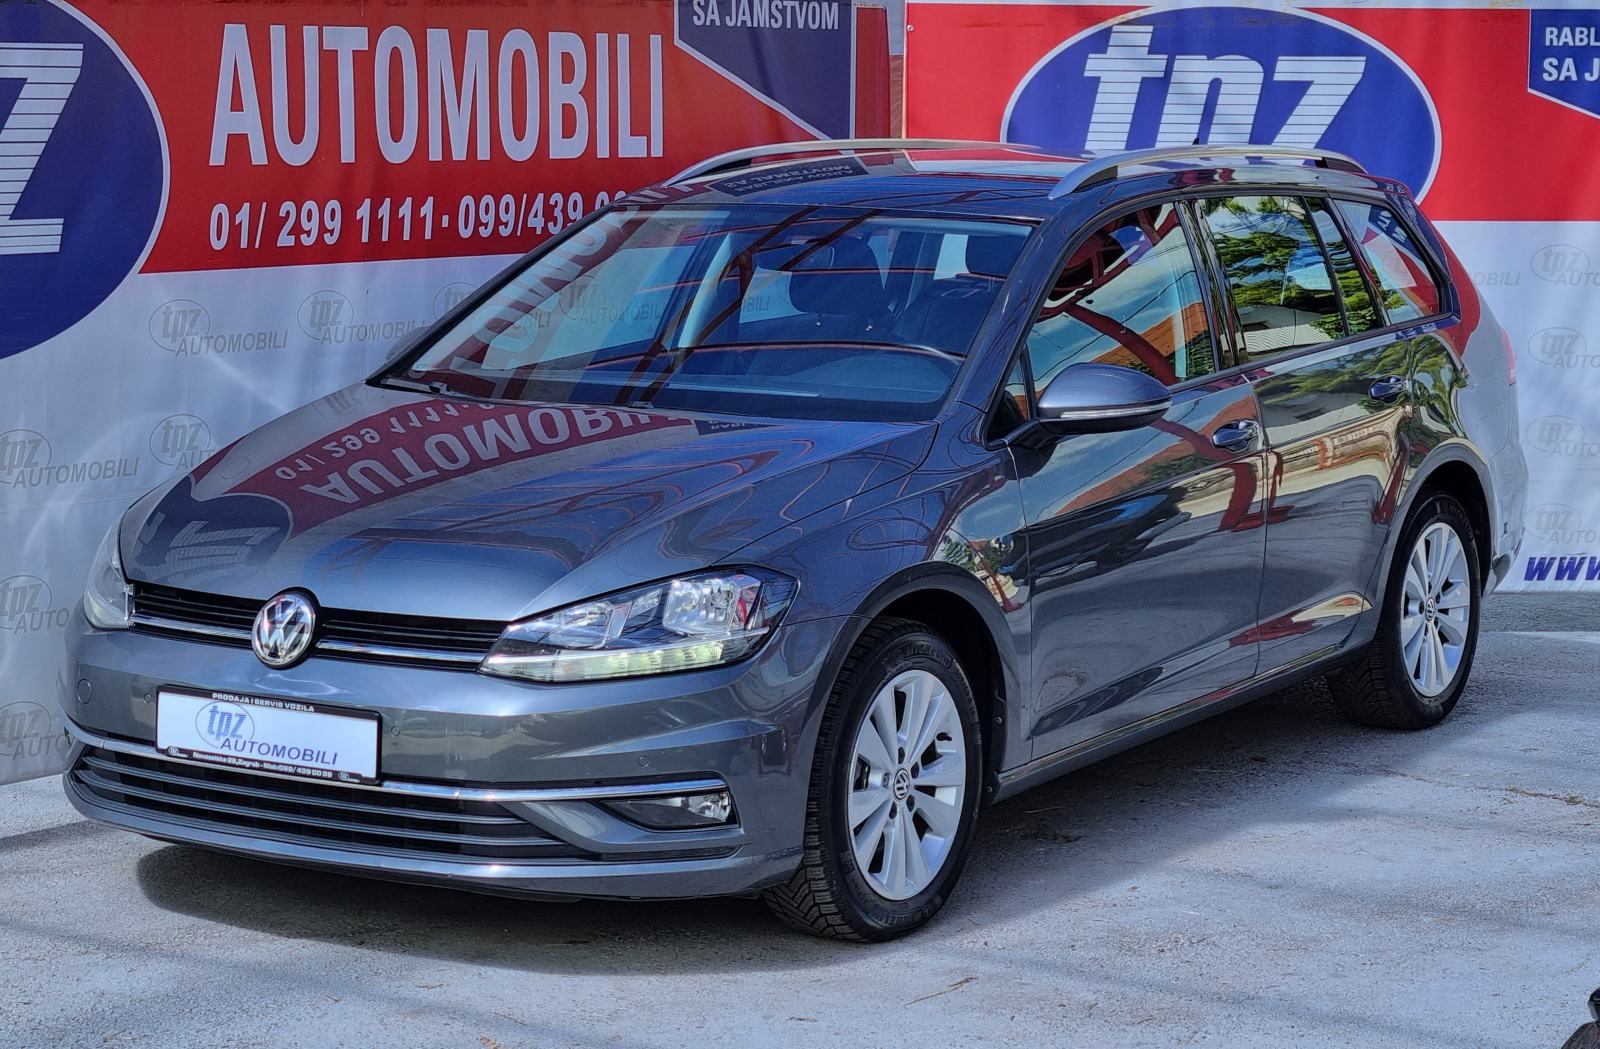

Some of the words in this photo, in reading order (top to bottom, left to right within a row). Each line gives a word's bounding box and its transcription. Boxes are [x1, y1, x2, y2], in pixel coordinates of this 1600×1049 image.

[693, 0, 721, 26] SA
[725, 0, 839, 30] JAMSTVOM
[1545, 26, 1600, 47] RABL
[1542, 57, 1578, 82] SA
[209, 23, 664, 167] AUTOMOBILI
[209, 202, 267, 250] 01/
[276, 200, 342, 246] 299
[175, 329, 289, 357] AUTOMOBILI
[320, 319, 426, 345] AUTOMOBI
[13, 456, 140, 490] AUTOMOBILI
[211, 692, 250, 704] PRODAJA
[255, 698, 285, 709] SERVIS
[284, 702, 315, 713] VOZILA
[206, 705, 247, 741] tpz
[220, 737, 338, 766] AUTOMOBILI
